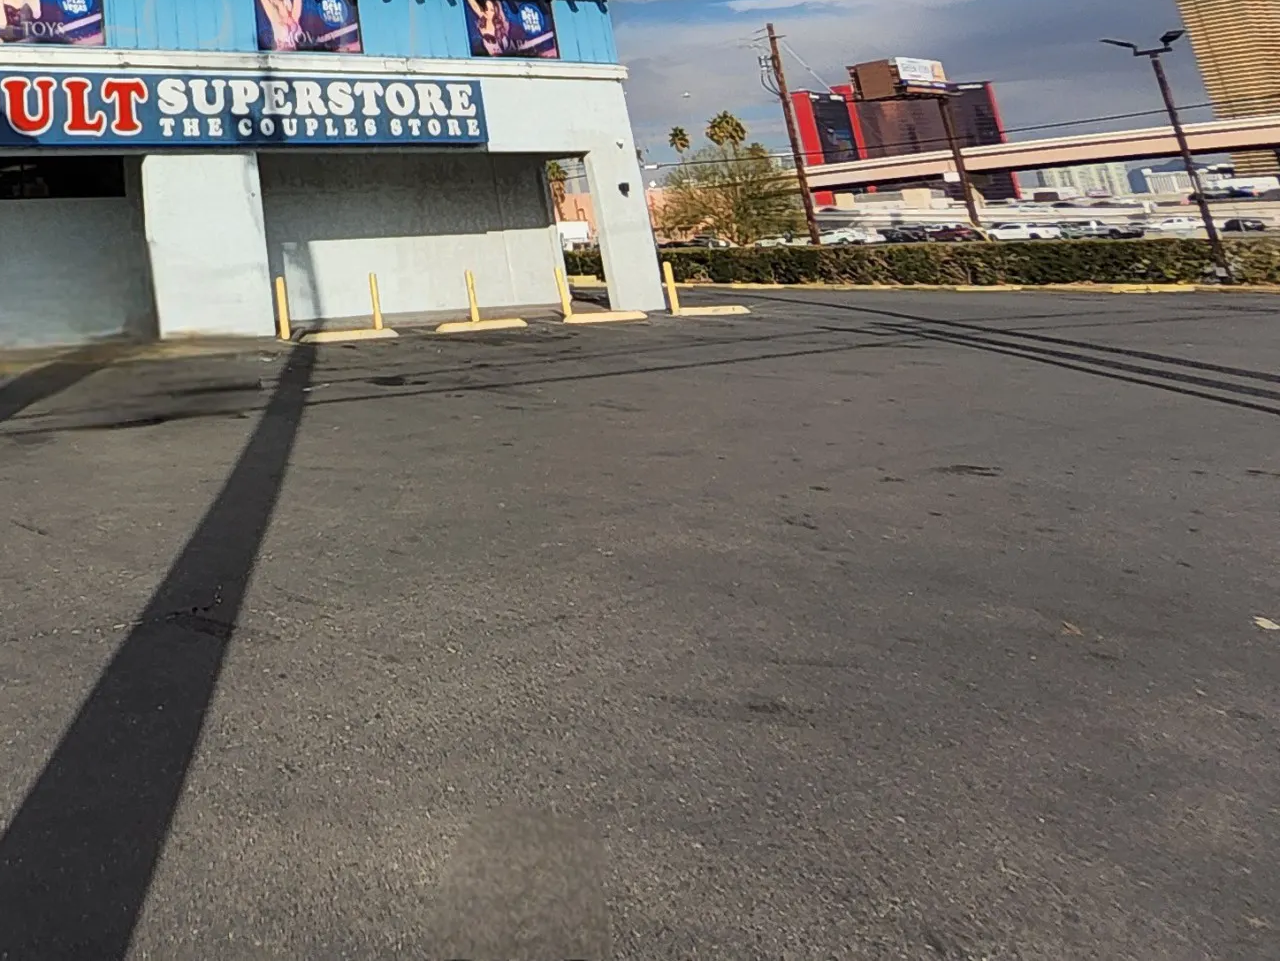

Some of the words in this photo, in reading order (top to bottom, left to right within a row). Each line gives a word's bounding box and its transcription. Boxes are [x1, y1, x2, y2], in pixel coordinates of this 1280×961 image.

[21, 21, 66, 37] TOYS
[157, 78, 477, 118] SUPERSTORE
[159, 118, 223, 137] THE
[238, 118, 376, 137] COUPLES
[389, 118, 480, 137] STORE
